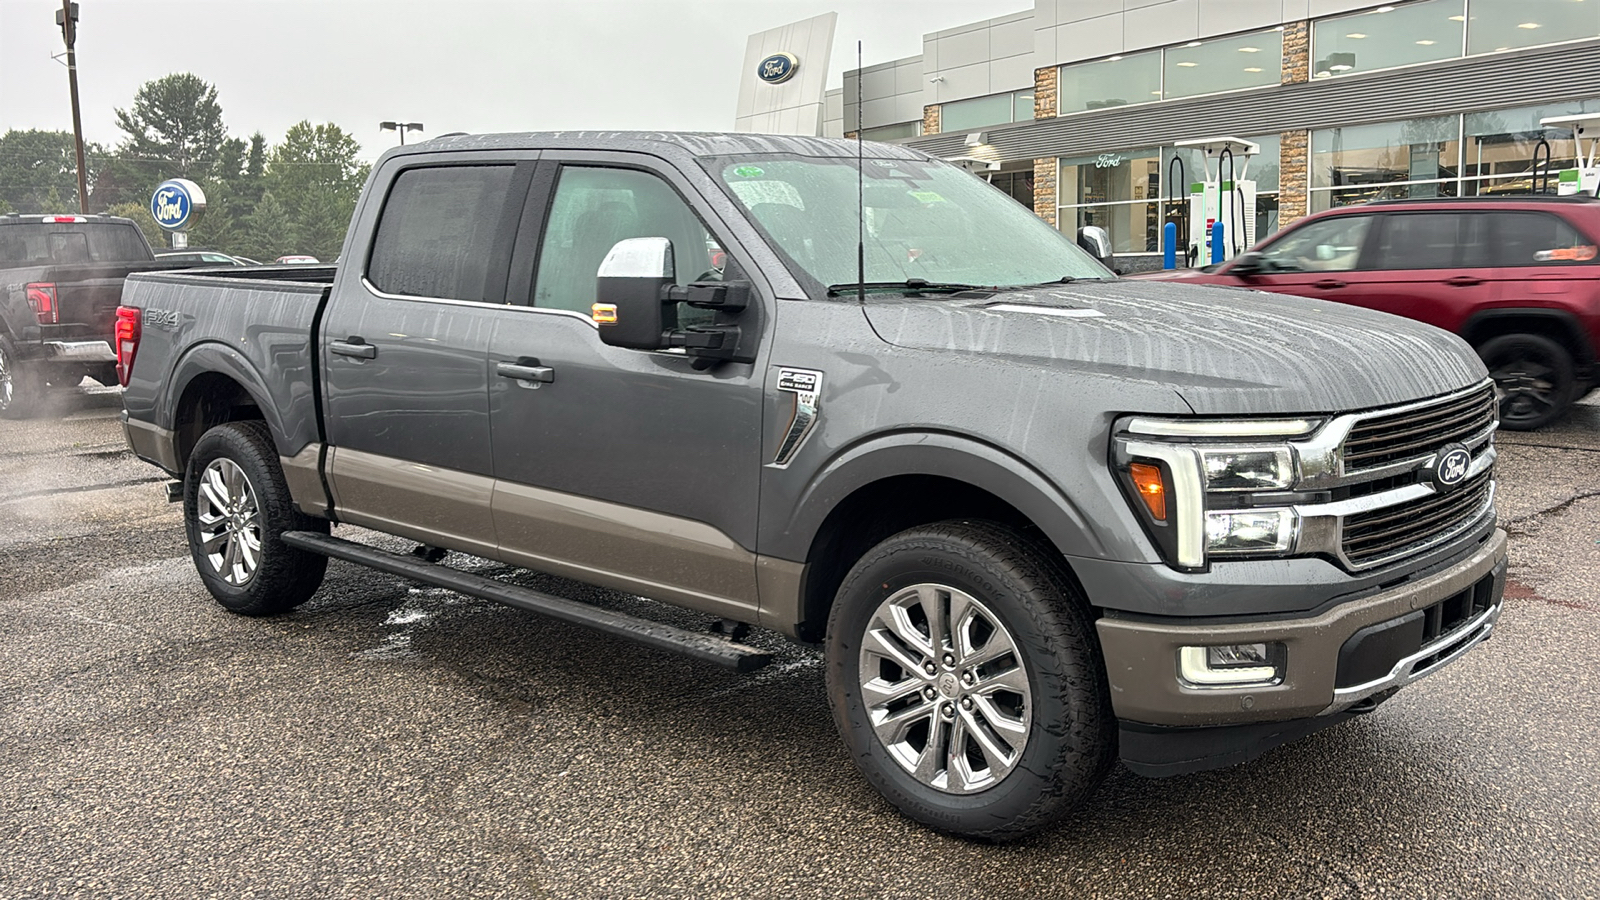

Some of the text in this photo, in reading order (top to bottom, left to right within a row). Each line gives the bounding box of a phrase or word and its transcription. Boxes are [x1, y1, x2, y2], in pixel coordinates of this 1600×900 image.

[763, 59, 784, 78] Ford
[1095, 153, 1121, 169] Ford
[156, 190, 183, 221] Ford
[144, 308, 181, 327] FX4
[1444, 454, 1466, 481] Ford
